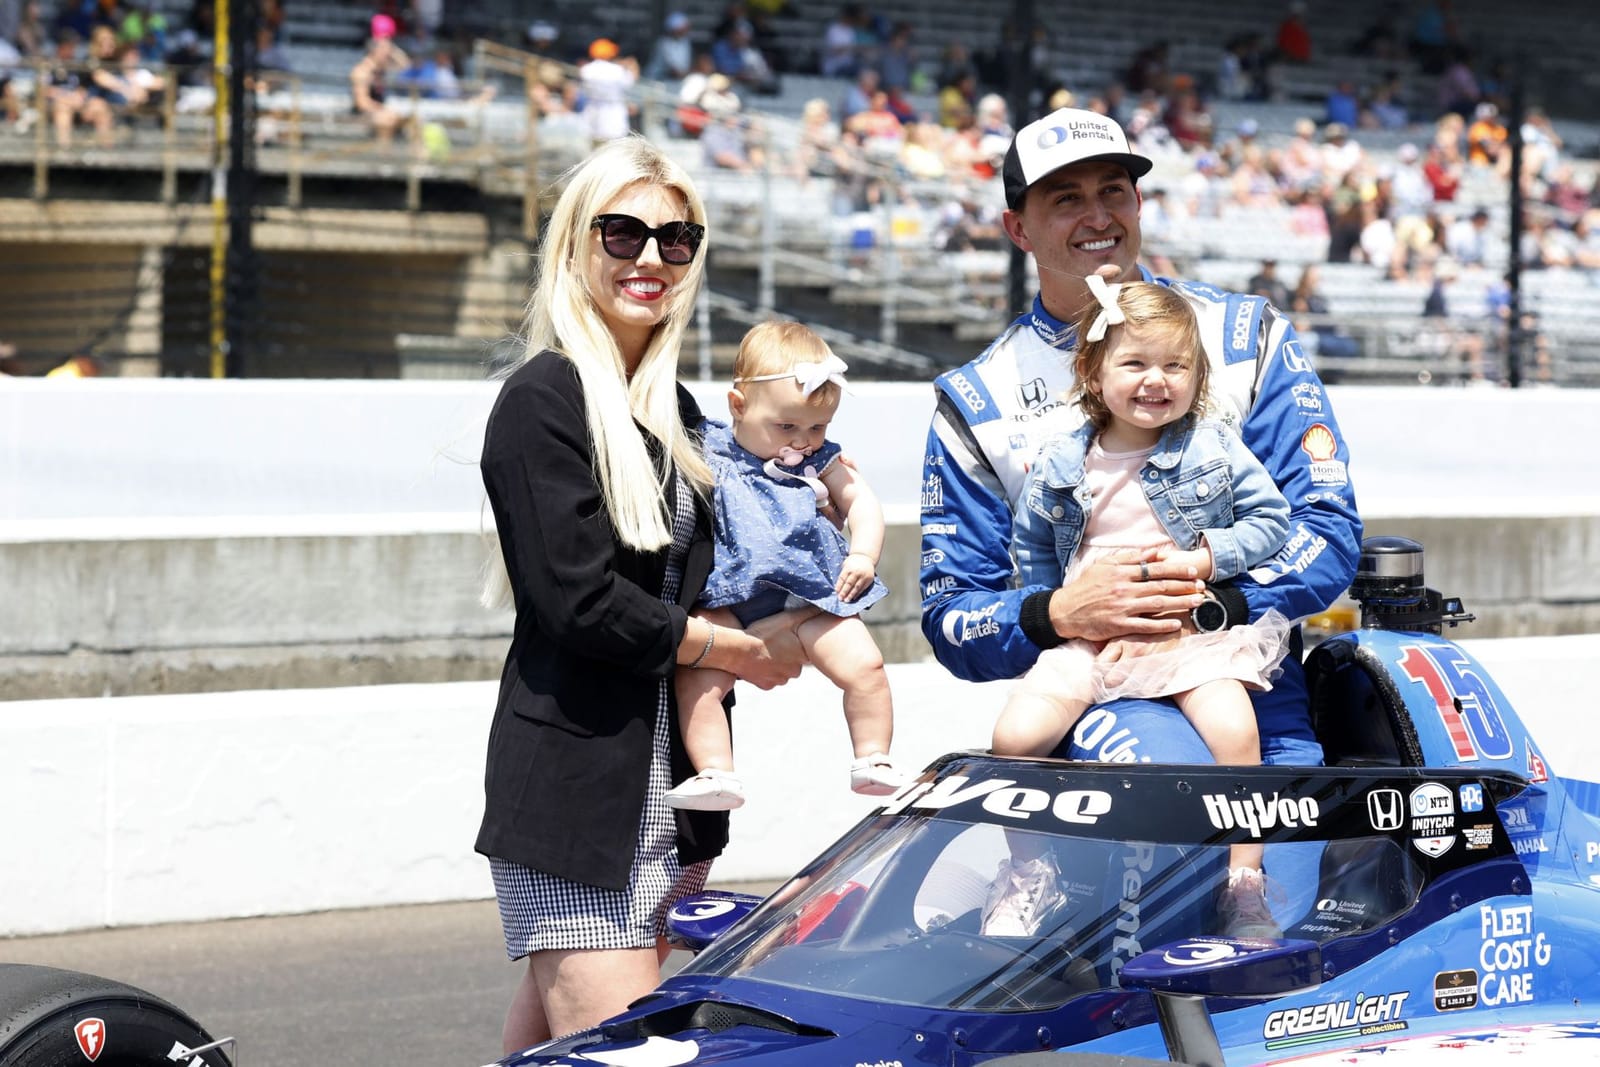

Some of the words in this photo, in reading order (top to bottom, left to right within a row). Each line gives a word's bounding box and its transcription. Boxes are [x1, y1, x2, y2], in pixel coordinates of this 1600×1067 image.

[1068, 120, 1108, 132] United
[947, 372, 986, 415] sparco
[1396, 645, 1513, 763] 15
[1430, 796, 1449, 809] NTT
[1412, 815, 1455, 831] INDYCAR
[1421, 828, 1447, 837] SERIES
[1335, 906, 1365, 915] Rentals
[1338, 901, 1366, 909] United
[1479, 903, 1533, 939] FLEET
[1534, 932, 1551, 966] &
[1361, 1021, 1406, 1036] collectibles
